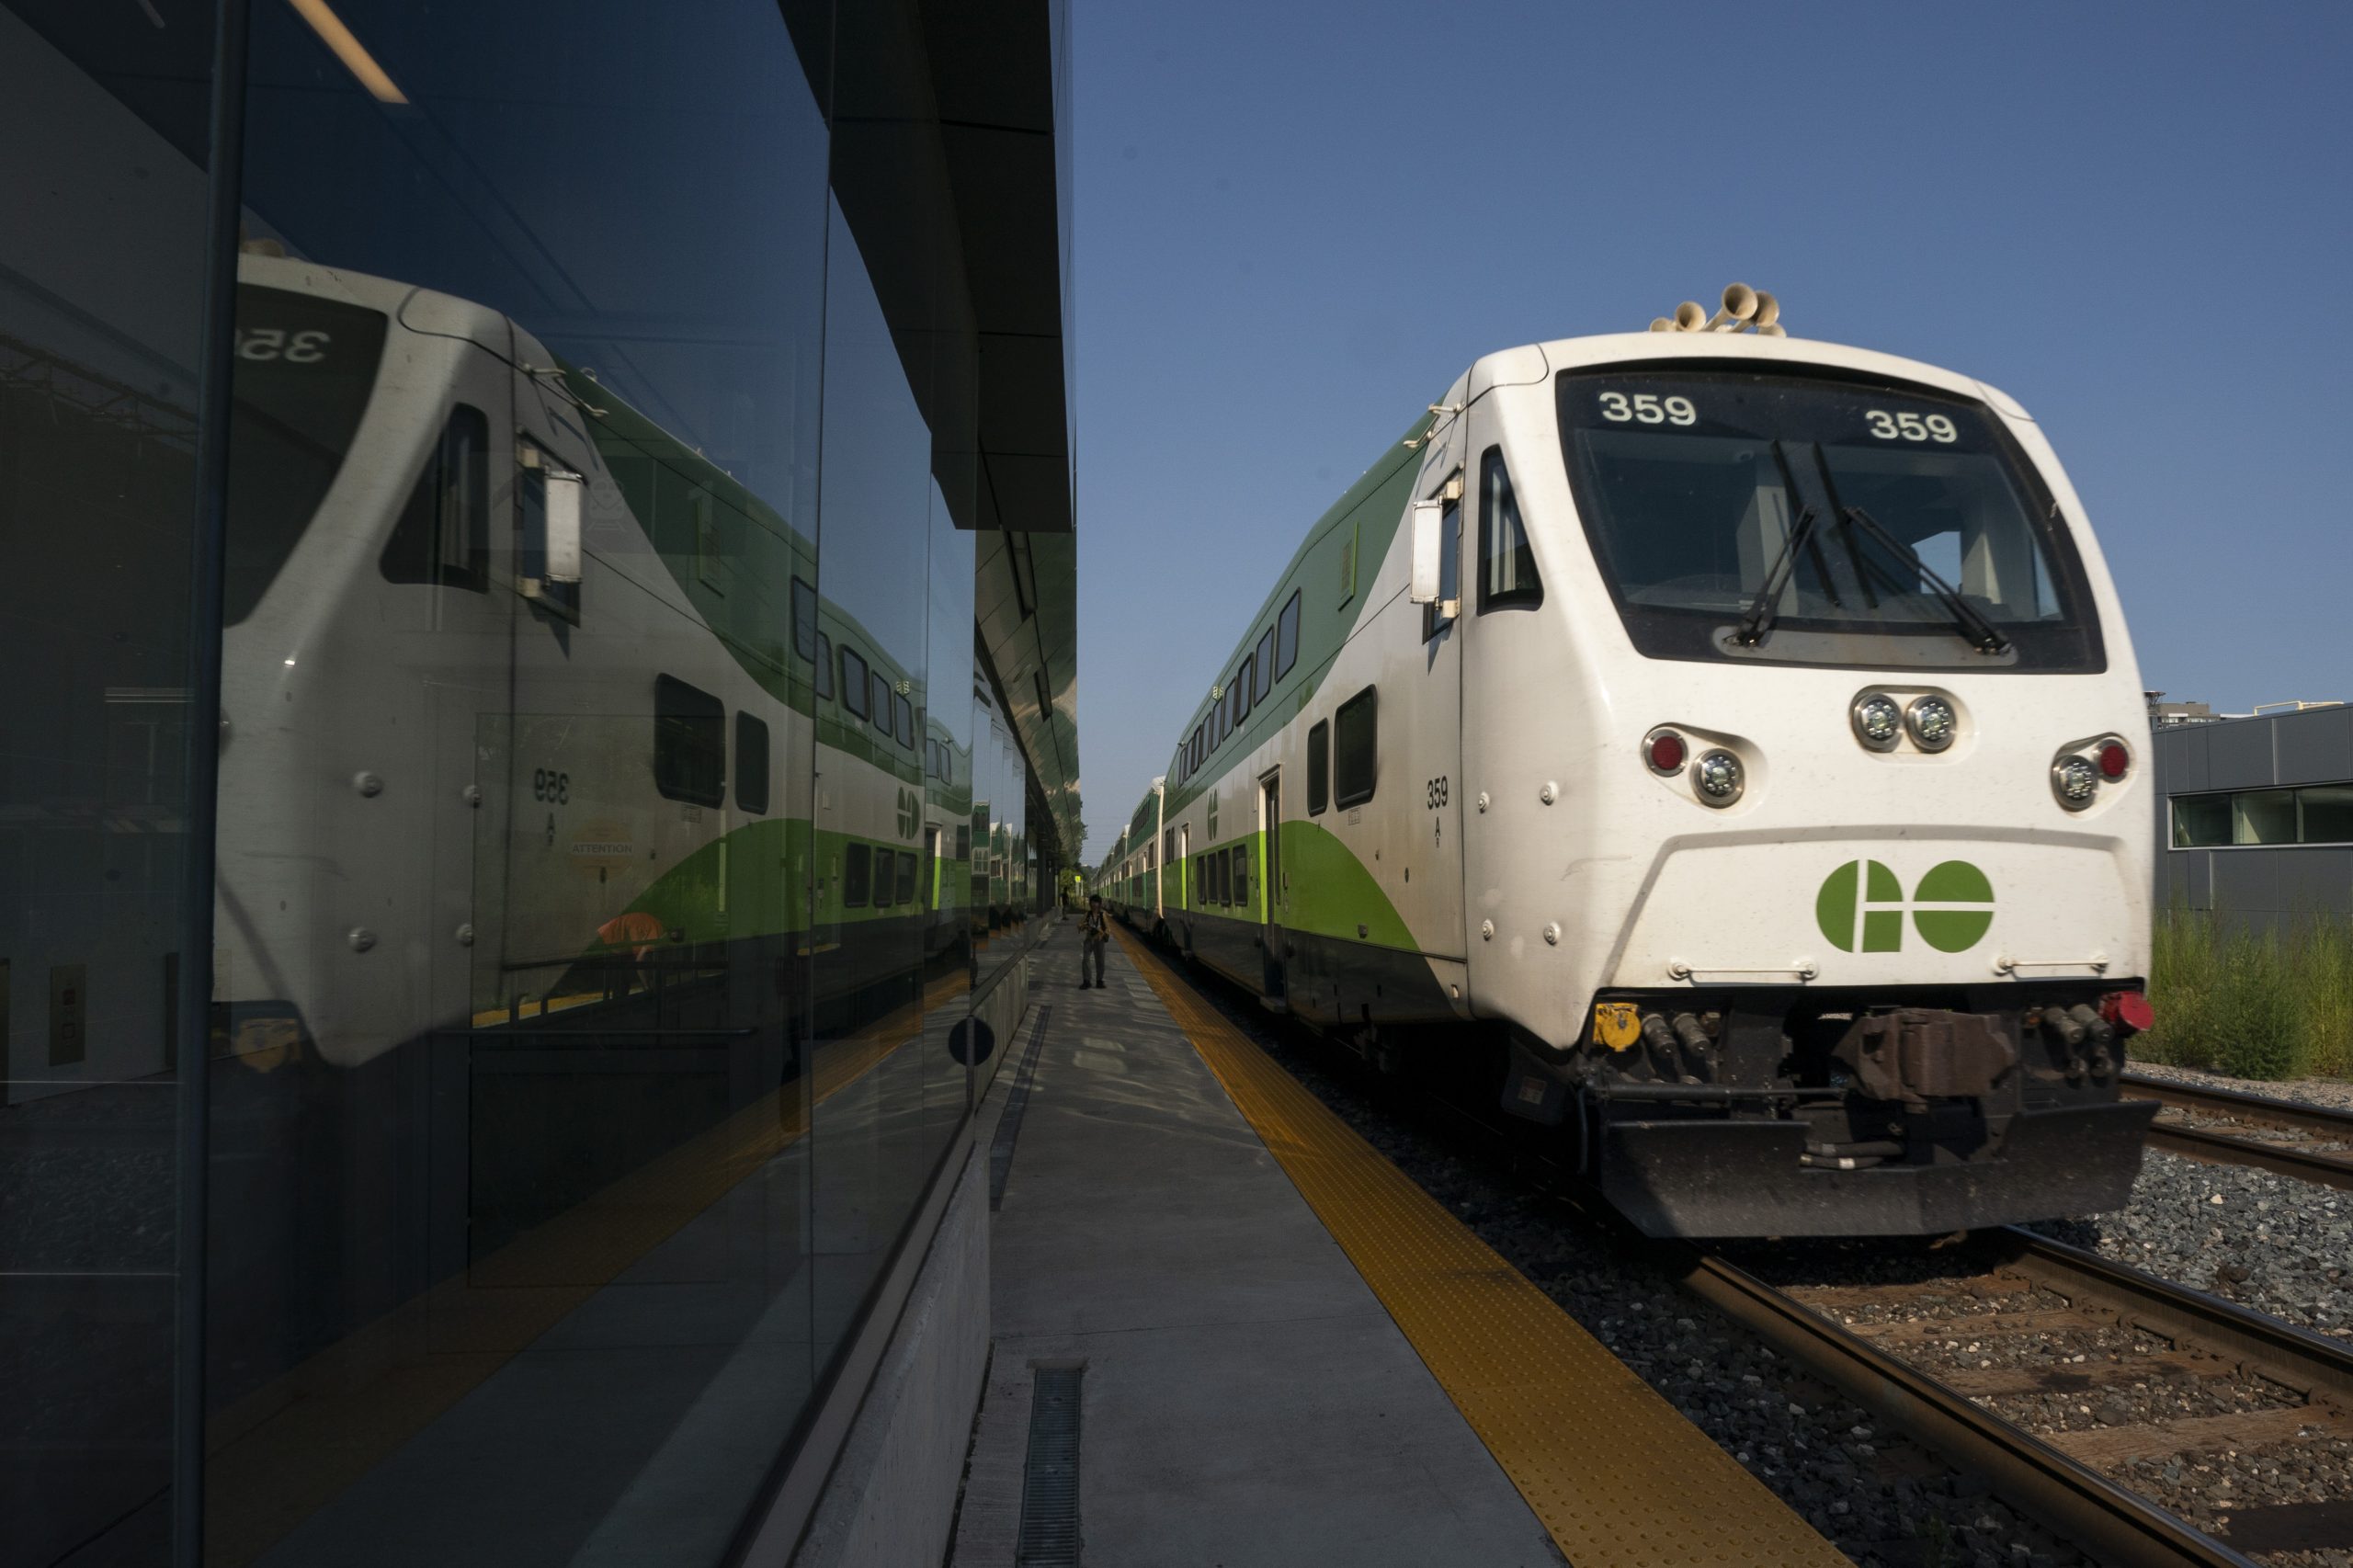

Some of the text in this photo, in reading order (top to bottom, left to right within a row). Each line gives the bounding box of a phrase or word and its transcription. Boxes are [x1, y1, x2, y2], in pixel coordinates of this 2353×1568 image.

[1598, 392, 1697, 426] 359
[1865, 409, 1959, 444] 359
[1427, 776, 1448, 810] 359
[1435, 816, 1440, 837] A
[573, 844, 632, 854] ATTENTION
[1816, 859, 1995, 953] GO
